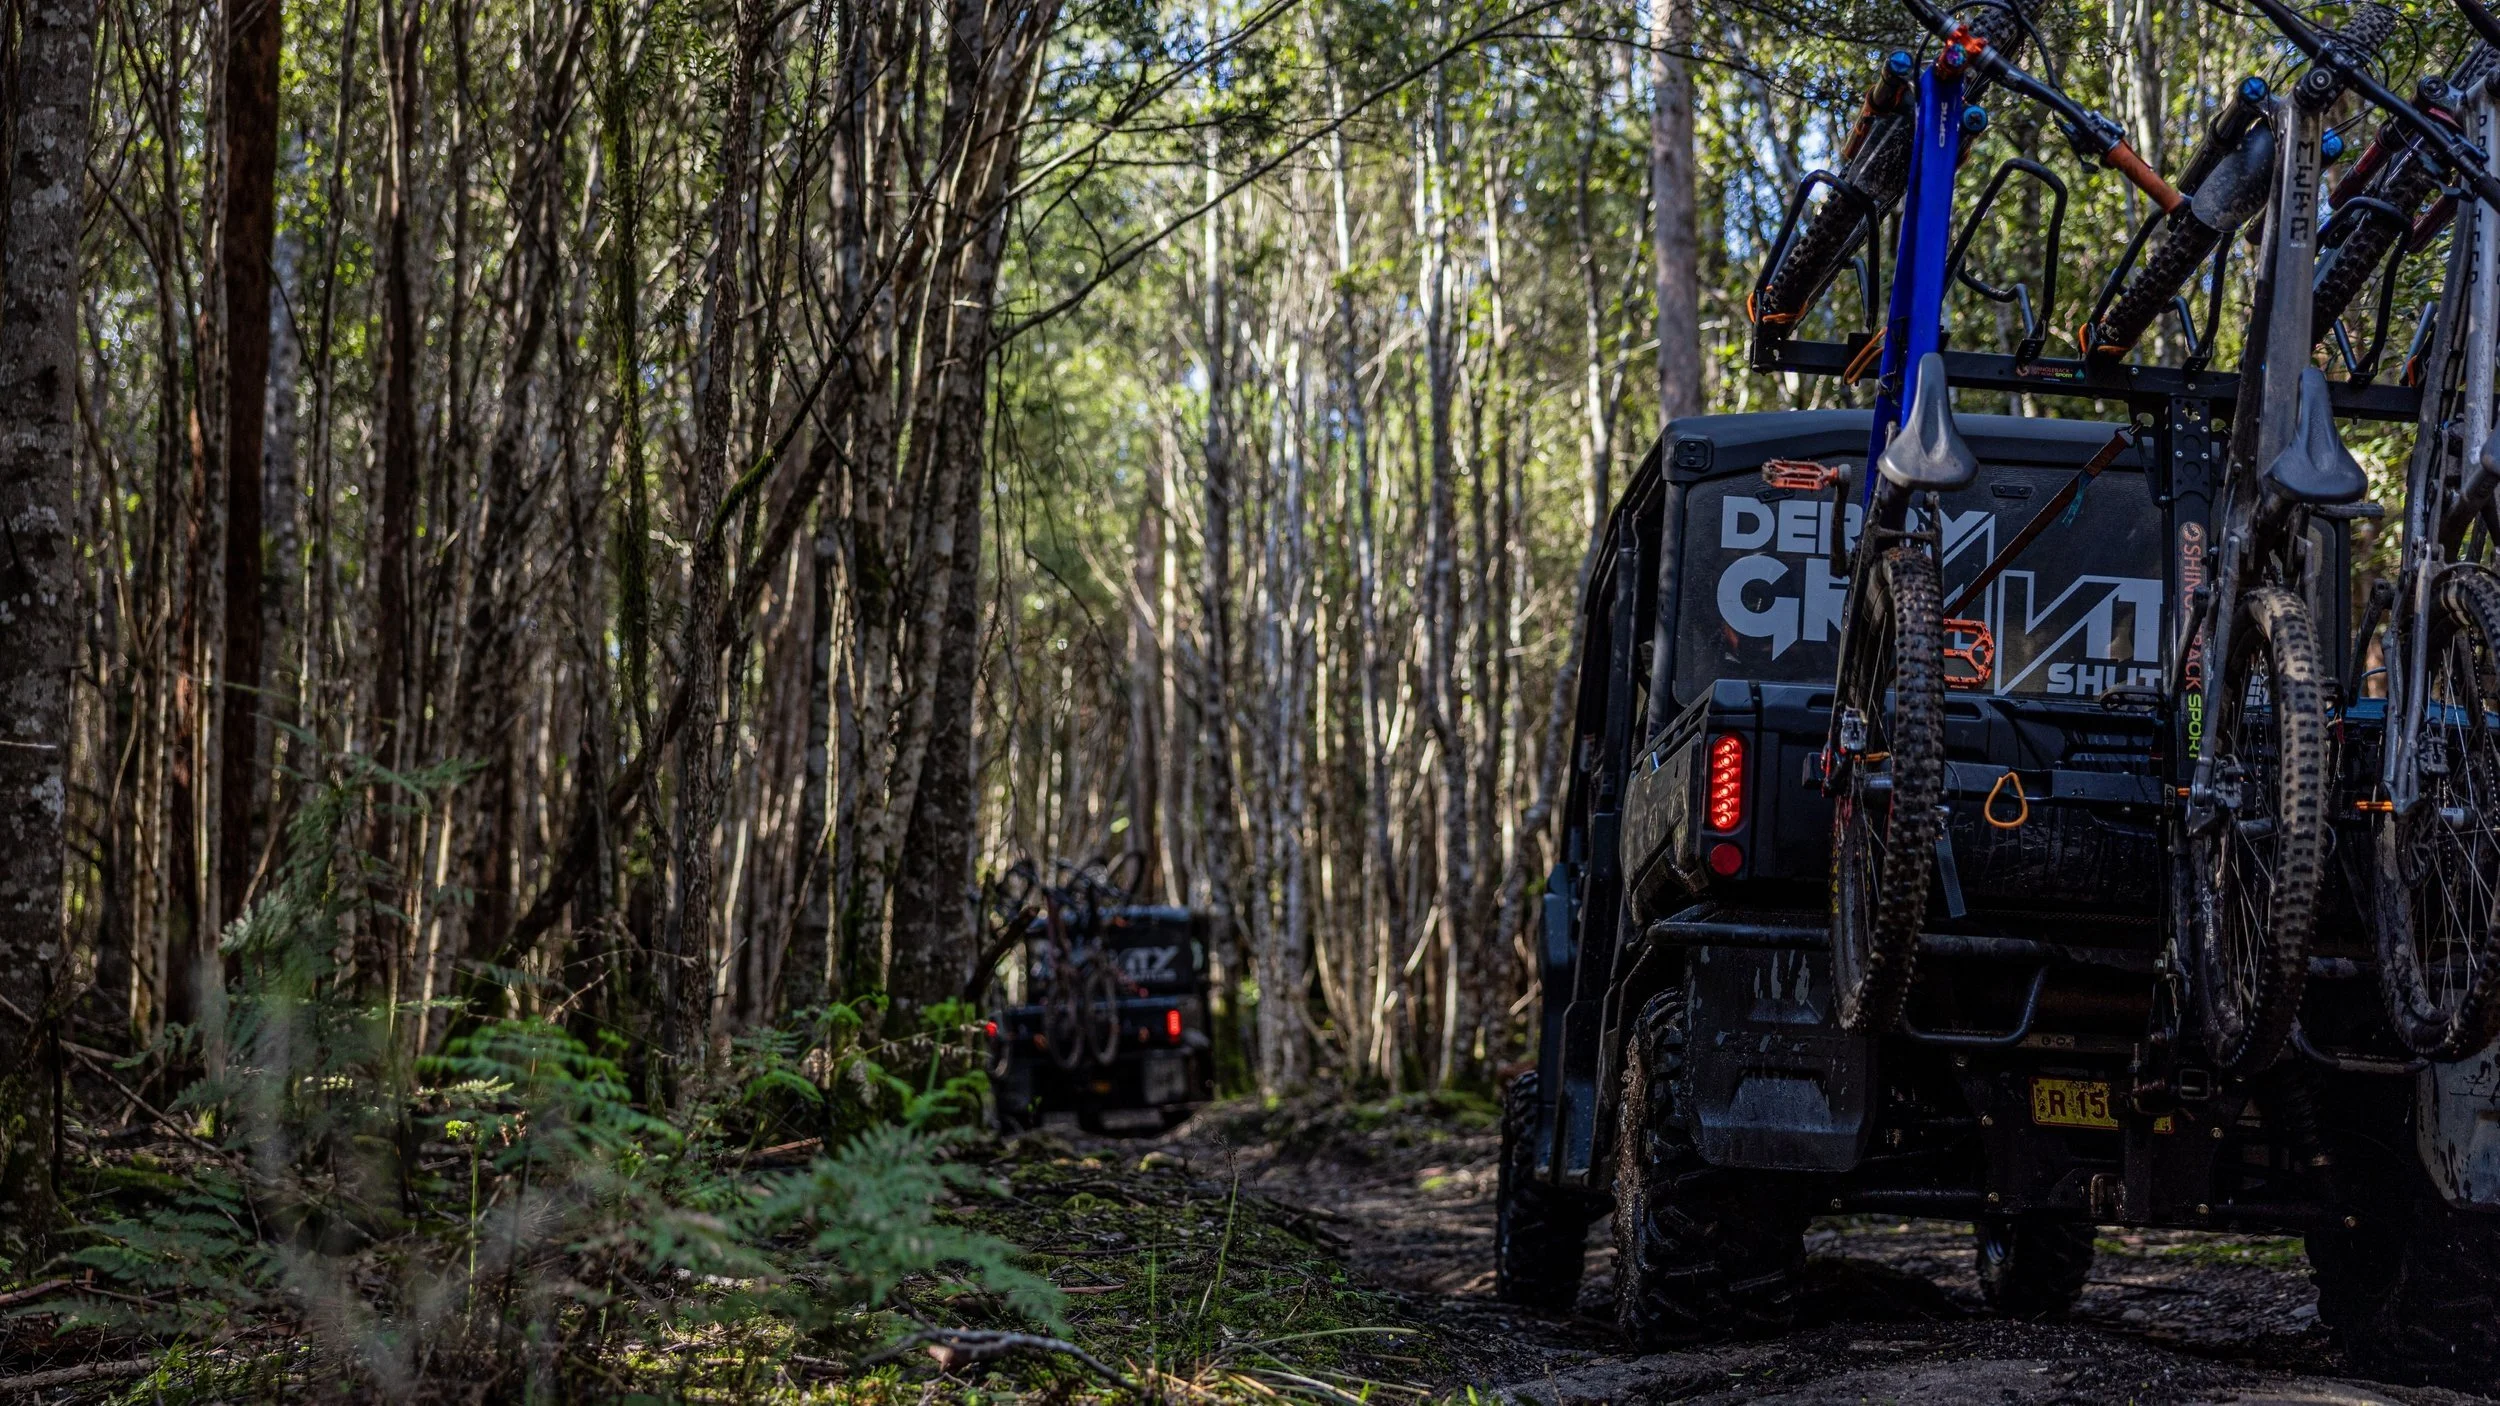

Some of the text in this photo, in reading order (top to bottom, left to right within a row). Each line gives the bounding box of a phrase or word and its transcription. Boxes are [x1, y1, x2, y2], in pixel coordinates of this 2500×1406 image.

[1939, 102, 1948, 147] OPTIC
[2046, 663, 2163, 697] SHUT
[2075, 1089, 2106, 1119] 15
